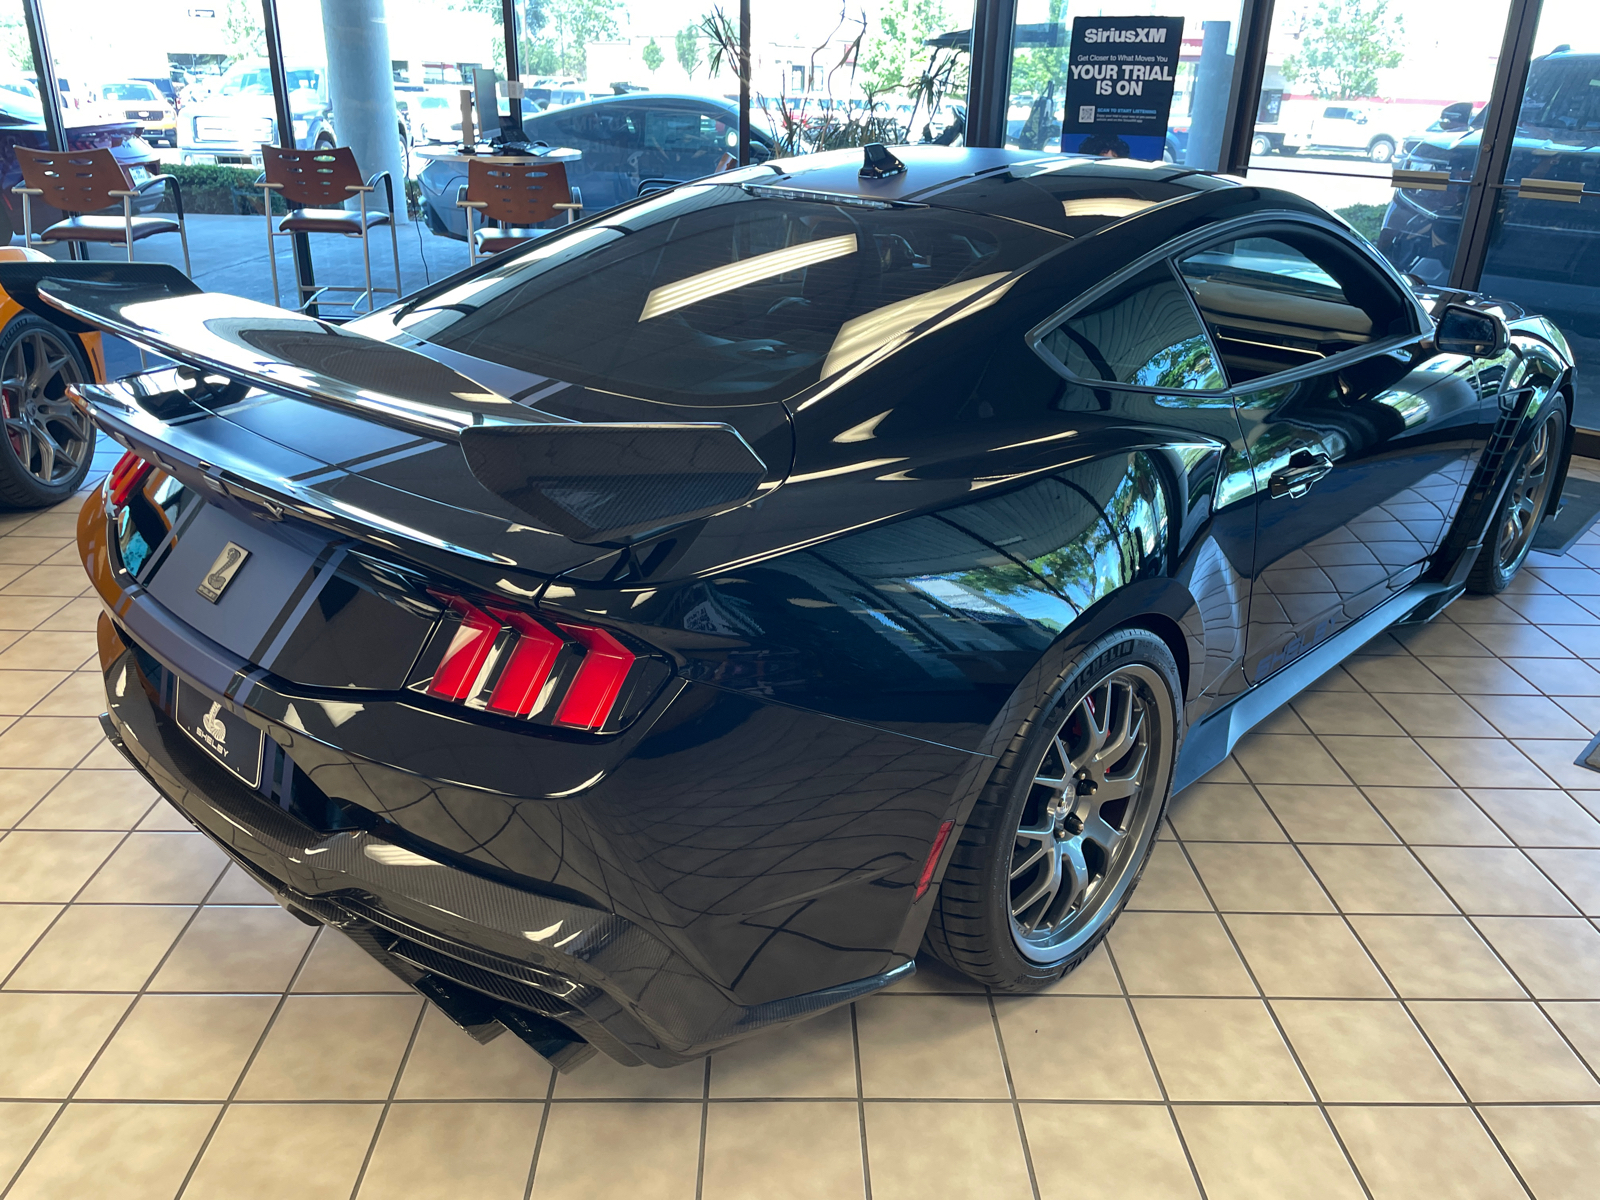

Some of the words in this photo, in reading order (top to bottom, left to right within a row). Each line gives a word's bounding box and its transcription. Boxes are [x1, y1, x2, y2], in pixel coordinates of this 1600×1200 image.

[1084, 27, 1167, 43] SiriusXM
[1077, 54, 1089, 62] Get
[1090, 54, 1109, 62] Closer
[1118, 54, 1134, 62] What
[1156, 55, 1168, 63] You
[1070, 64, 1118, 80] YOUR
[1122, 65, 1173, 81] TRIAL
[1095, 80, 1113, 95] IS
[1116, 80, 1143, 96] ON
[1063, 641, 1133, 704] MICHELIN
[196, 726, 230, 758] SHELBY
